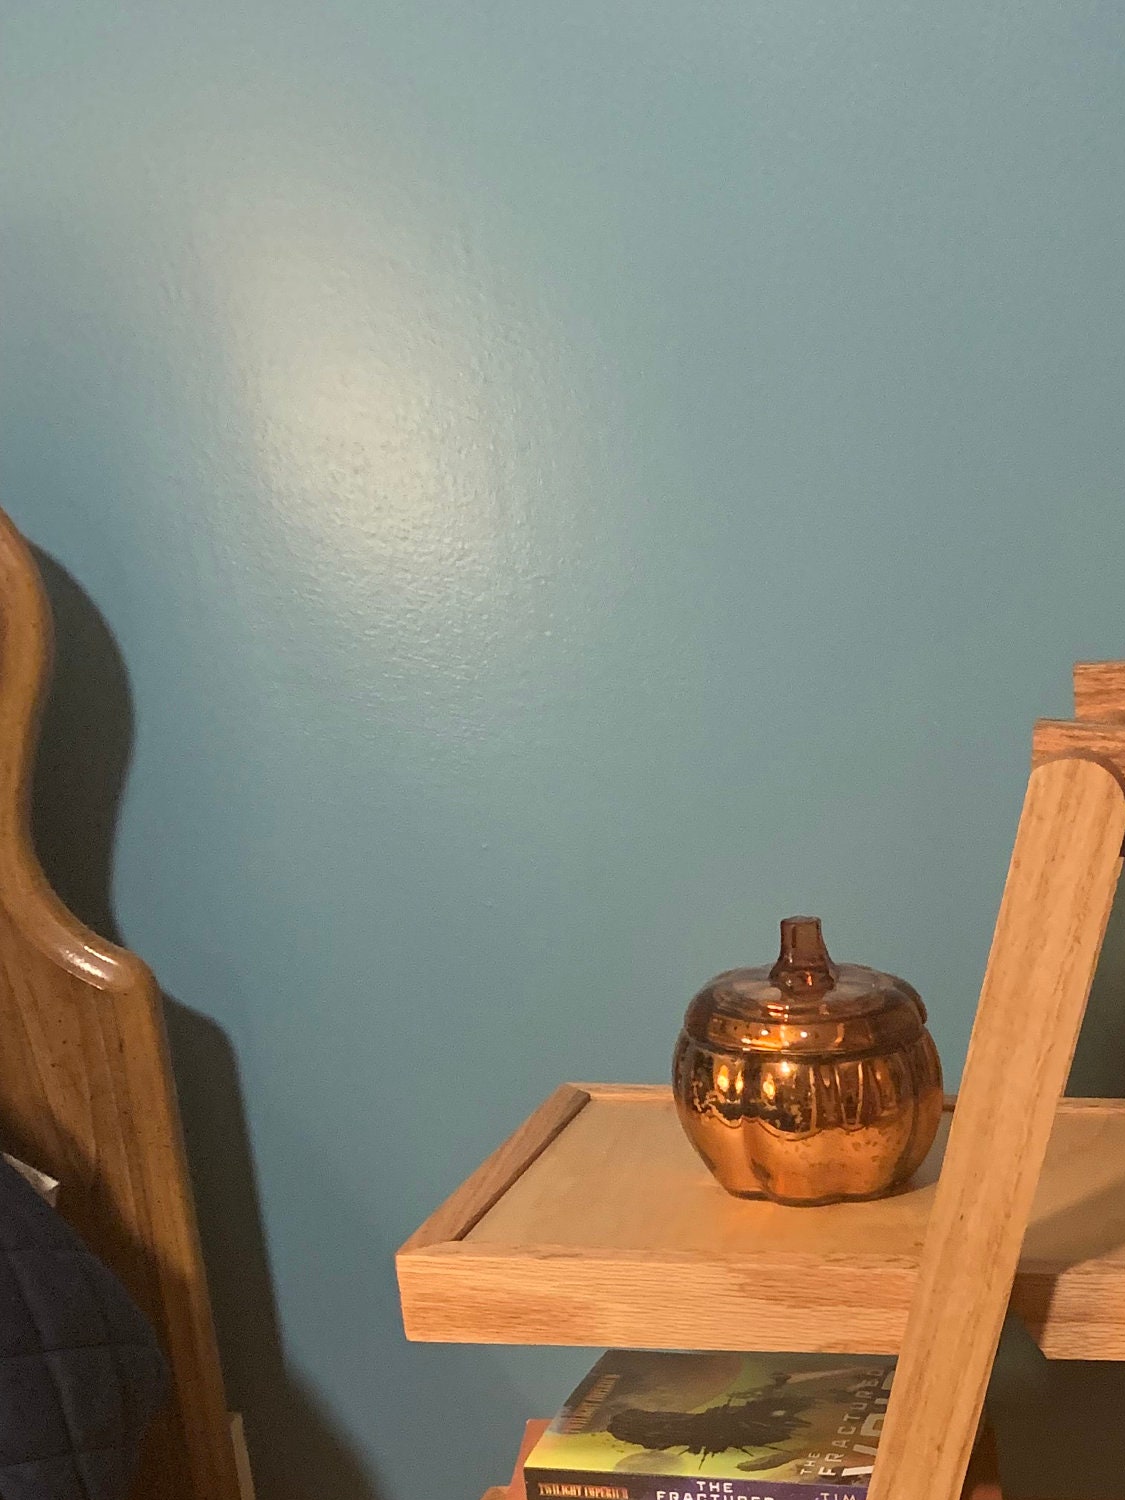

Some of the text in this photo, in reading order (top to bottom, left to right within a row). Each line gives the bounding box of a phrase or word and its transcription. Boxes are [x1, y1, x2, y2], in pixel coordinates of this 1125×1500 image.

[818, 1369, 884, 1476] FRACTURED
[800, 1452, 820, 1475] THE
[697, 1481, 733, 1494] THE
